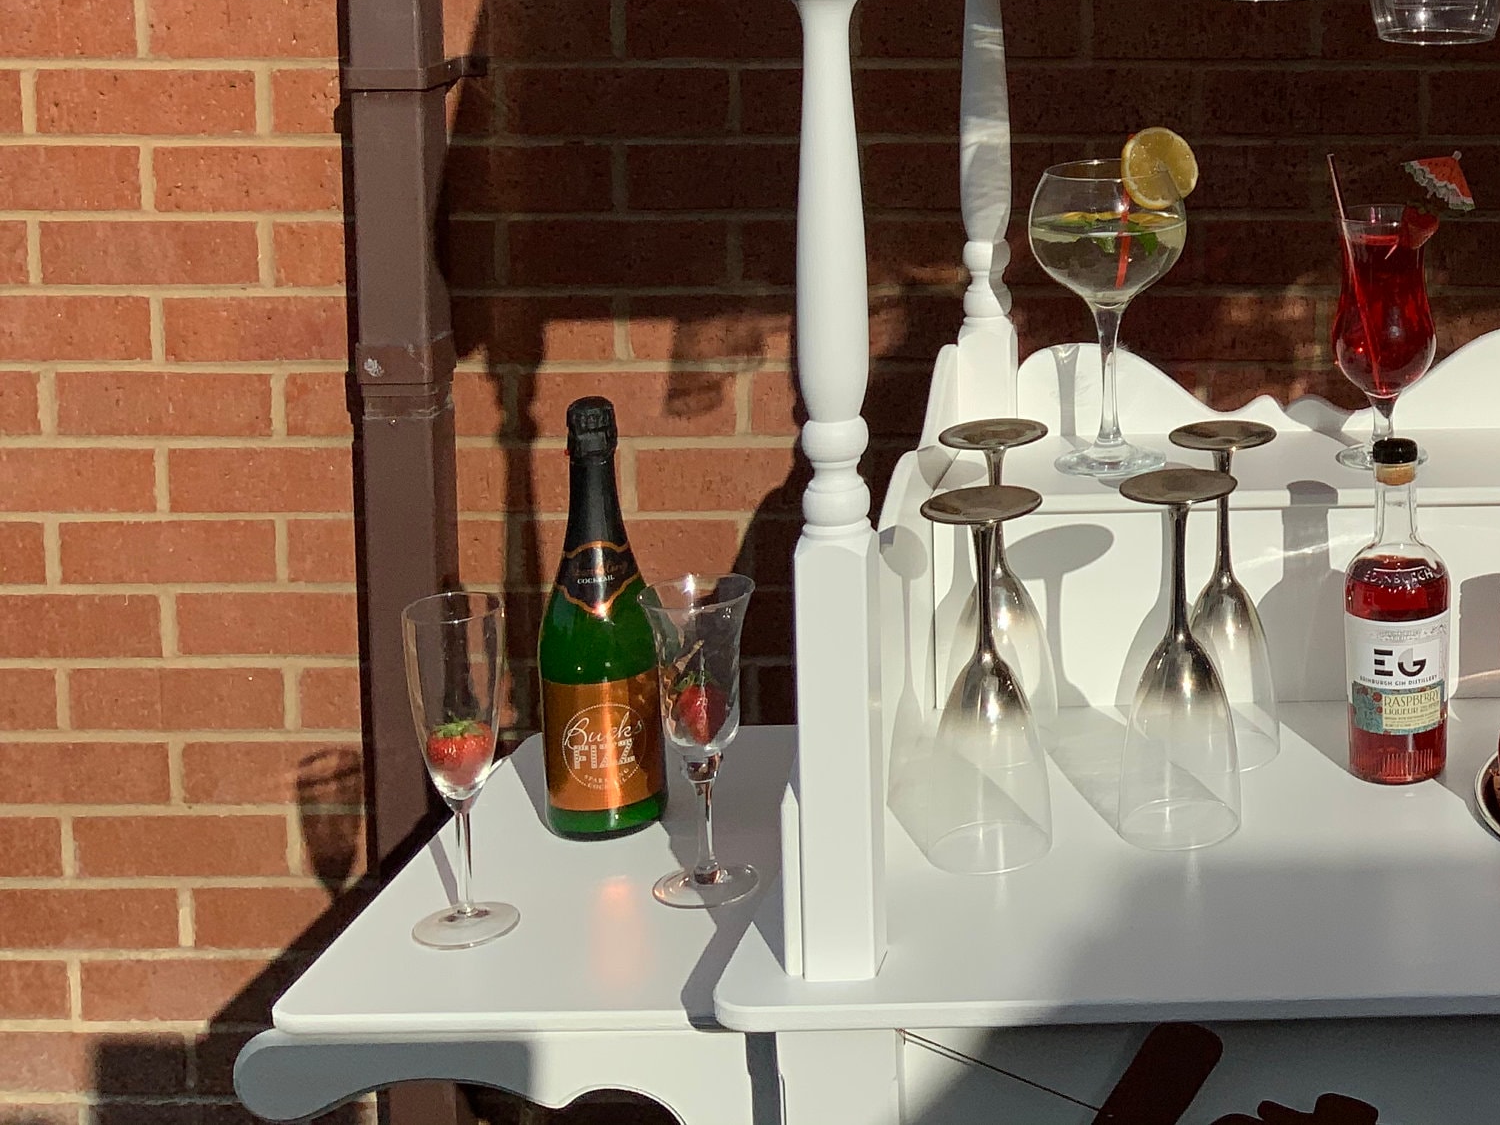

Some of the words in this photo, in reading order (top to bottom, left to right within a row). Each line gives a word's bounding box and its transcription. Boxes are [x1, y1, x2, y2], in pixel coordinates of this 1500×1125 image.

[577, 575, 615, 584] COCKAIL
[1373, 648, 1427, 677] EG
[1359, 675, 1393, 686] EDINBURGH
[1383, 689, 1439, 708] RASPBERRY
[573, 738, 636, 770] FIZZ
[584, 768, 630, 784] SPARNG
